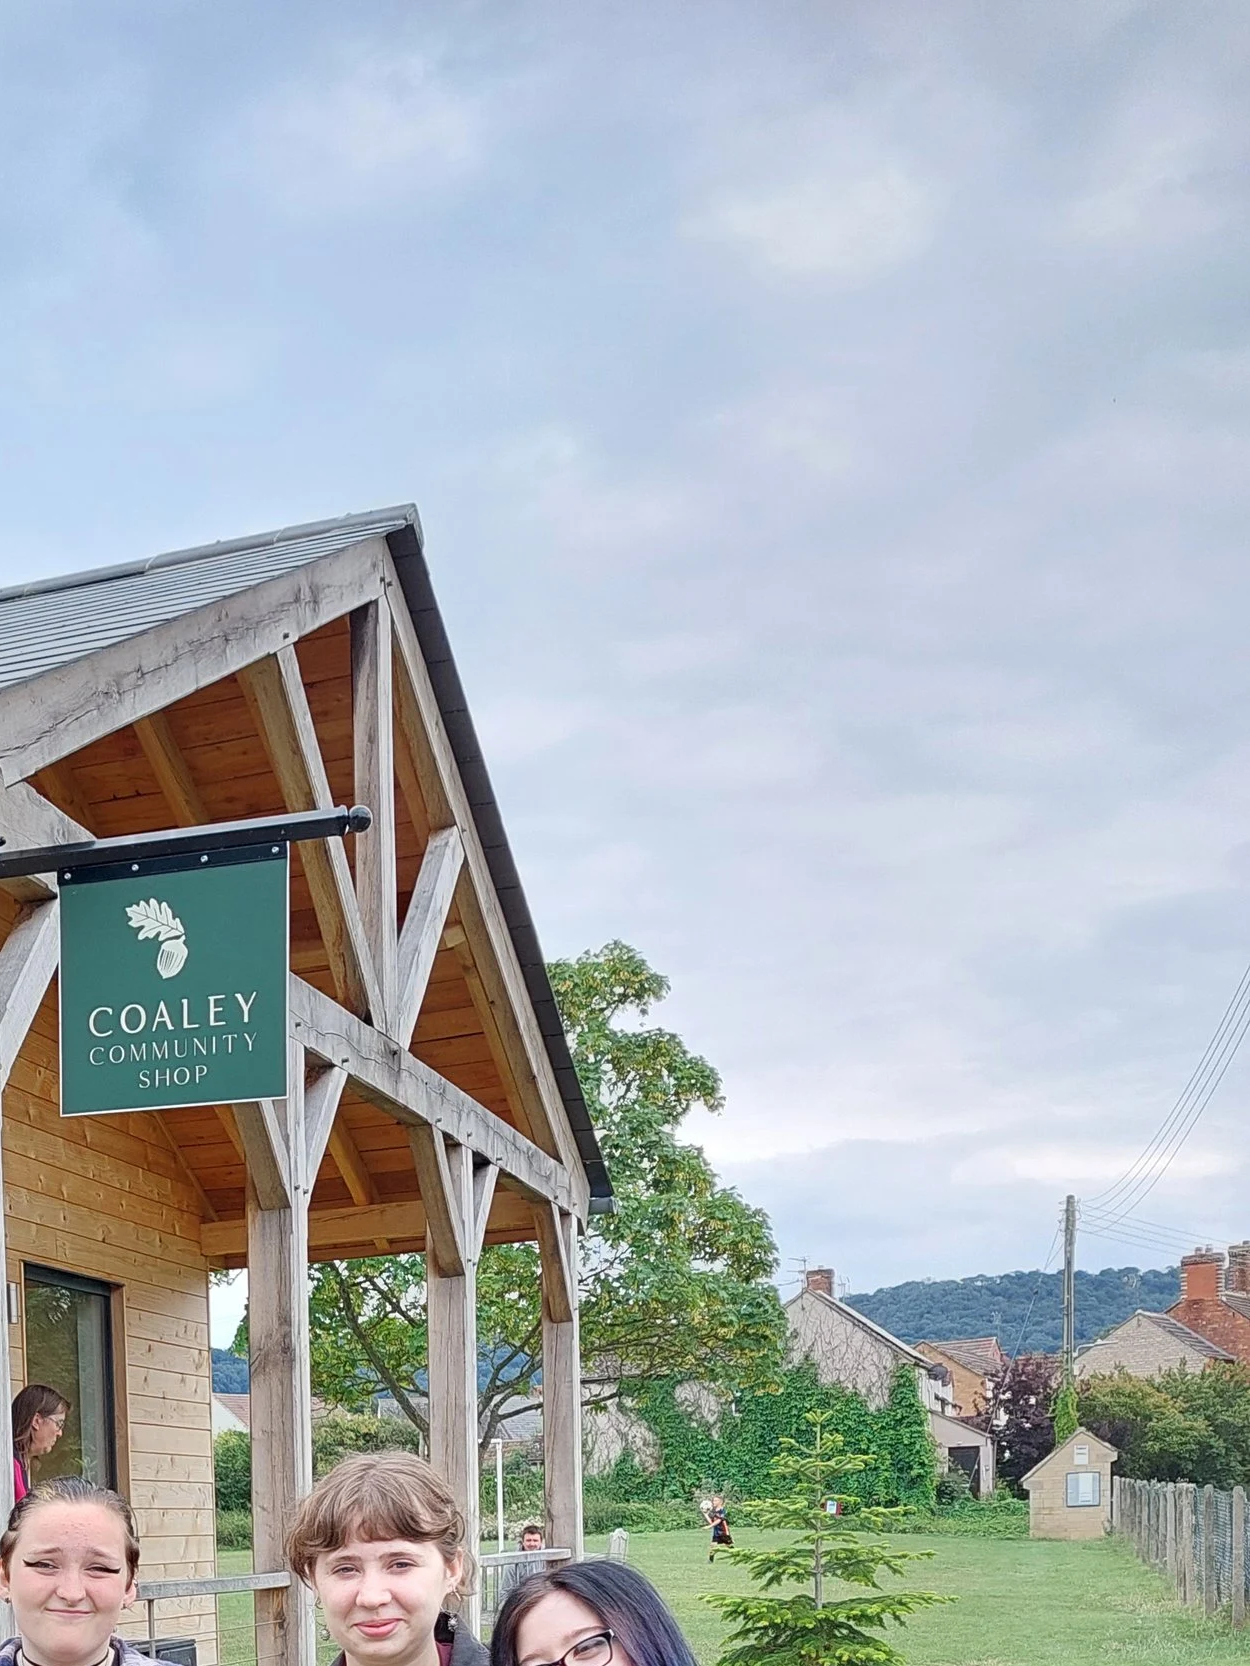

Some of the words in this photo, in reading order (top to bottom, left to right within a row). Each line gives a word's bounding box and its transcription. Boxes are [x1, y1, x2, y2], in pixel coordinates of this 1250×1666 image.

[88, 991, 257, 1037] COALEY
[89, 1032, 257, 1066] COMMUNITY
[138, 1064, 208, 1089] SHOP
